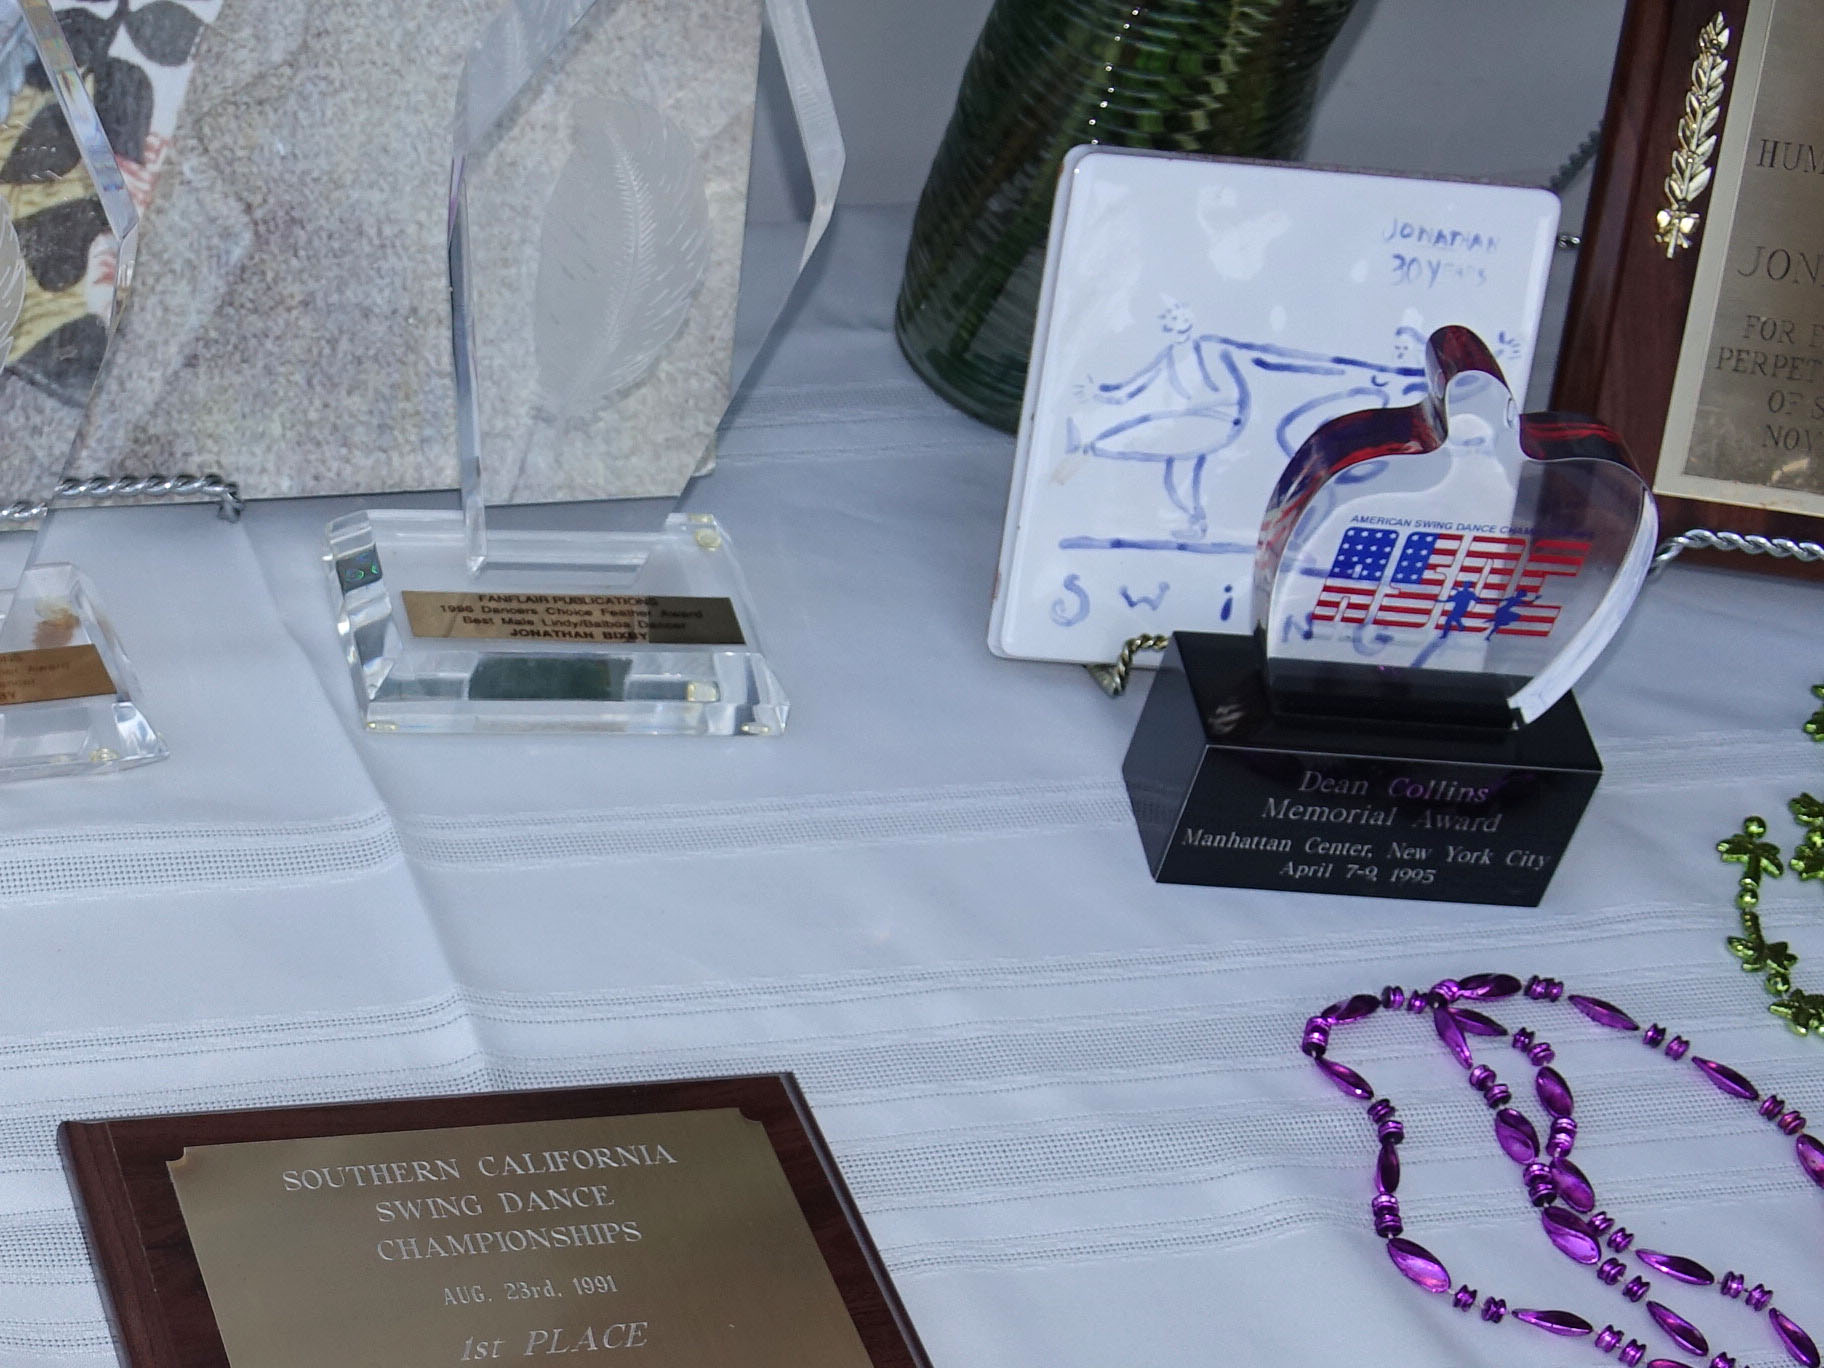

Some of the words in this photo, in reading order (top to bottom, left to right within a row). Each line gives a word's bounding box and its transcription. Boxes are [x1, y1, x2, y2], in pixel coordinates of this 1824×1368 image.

[1391, 252, 1422, 286] 30
[1736, 245, 1824, 287] JON
[1742, 314, 1795, 345] FOR
[1350, 514, 1410, 528] AMERICAN
[1414, 518, 1453, 531] SWING
[1456, 521, 1496, 534] DANCE
[463, 615, 495, 625] Best
[481, 605, 538, 615] Dancers
[545, 606, 593, 616] Choice
[600, 608, 651, 618] Feather
[510, 628, 595, 640] JONATHAN
[1298, 770, 1369, 796] Dean
[1388, 777, 1490, 803] Collins
[1261, 797, 1398, 826] Memorial
[1411, 808, 1503, 833] Award
[1182, 828, 1292, 852] Manhattan
[1304, 836, 1374, 858] Center,
[1386, 841, 1433, 861] New
[1445, 845, 1494, 866] York
[1505, 849, 1551, 871] City
[1280, 860, 1334, 880] April
[1390, 867, 1437, 884] 1995
[281, 1157, 462, 1192] SOUTHERN
[477, 1143, 678, 1178] CALIFORNIA
[376, 1194, 482, 1223] SWING
[497, 1184, 615, 1214] DANCE
[376, 1220, 643, 1262] CHAMPIONSHIPS
[442, 1285, 493, 1306] AUG.
[572, 1274, 619, 1296] 1991
[460, 1335, 506, 1361] 1st
[522, 1321, 649, 1356] PLACE
